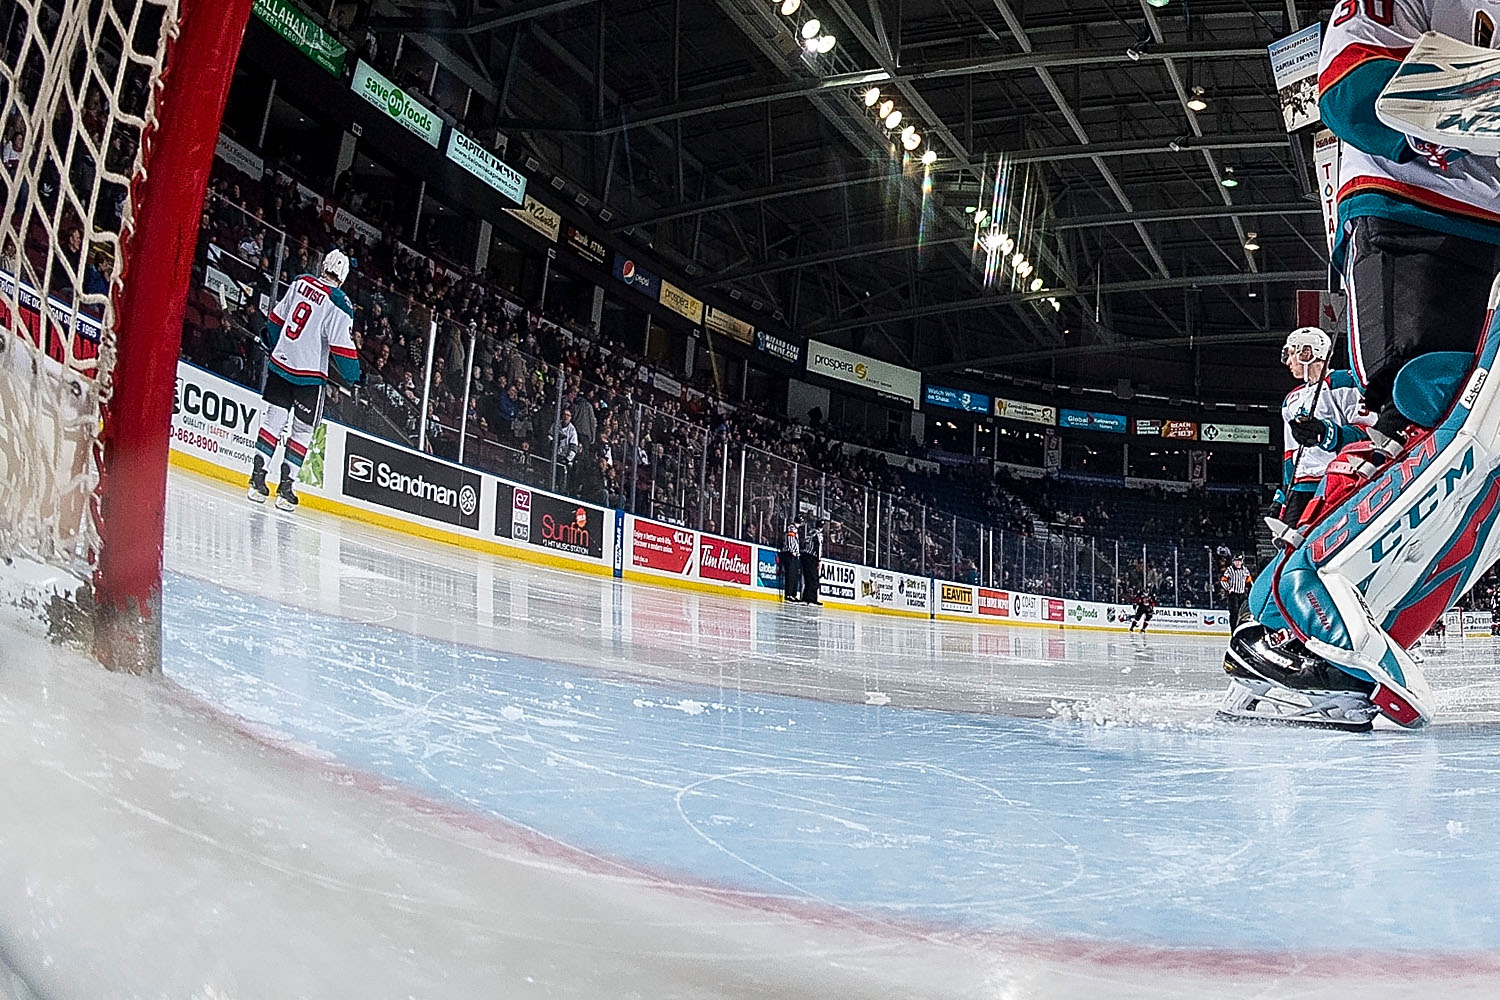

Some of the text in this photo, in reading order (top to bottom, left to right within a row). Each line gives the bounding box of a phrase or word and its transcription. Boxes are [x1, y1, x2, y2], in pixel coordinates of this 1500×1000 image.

[1275, 58, 1296, 73] CAPITAL
[365, 77, 432, 131] save on foods
[456, 135, 490, 164] CAPITAL
[285, 301, 313, 341] 9
[814, 353, 854, 374] prospera
[183, 383, 258, 435] CODY
[169, 425, 219, 454] 0-862-8900
[209, 425, 230, 441] SAFETY
[376, 462, 458, 508] Sandman
[1305, 433, 1438, 563] CCM
[1368, 445, 1475, 565] CCM
[701, 544, 751, 576] Tim Hortons
[758, 560, 778, 574] Global
[820, 563, 856, 585] AM 1150
[942, 585, 973, 602] LEAVITT
[1022, 596, 1037, 609] COAST
[1082, 607, 1099, 619] foods
